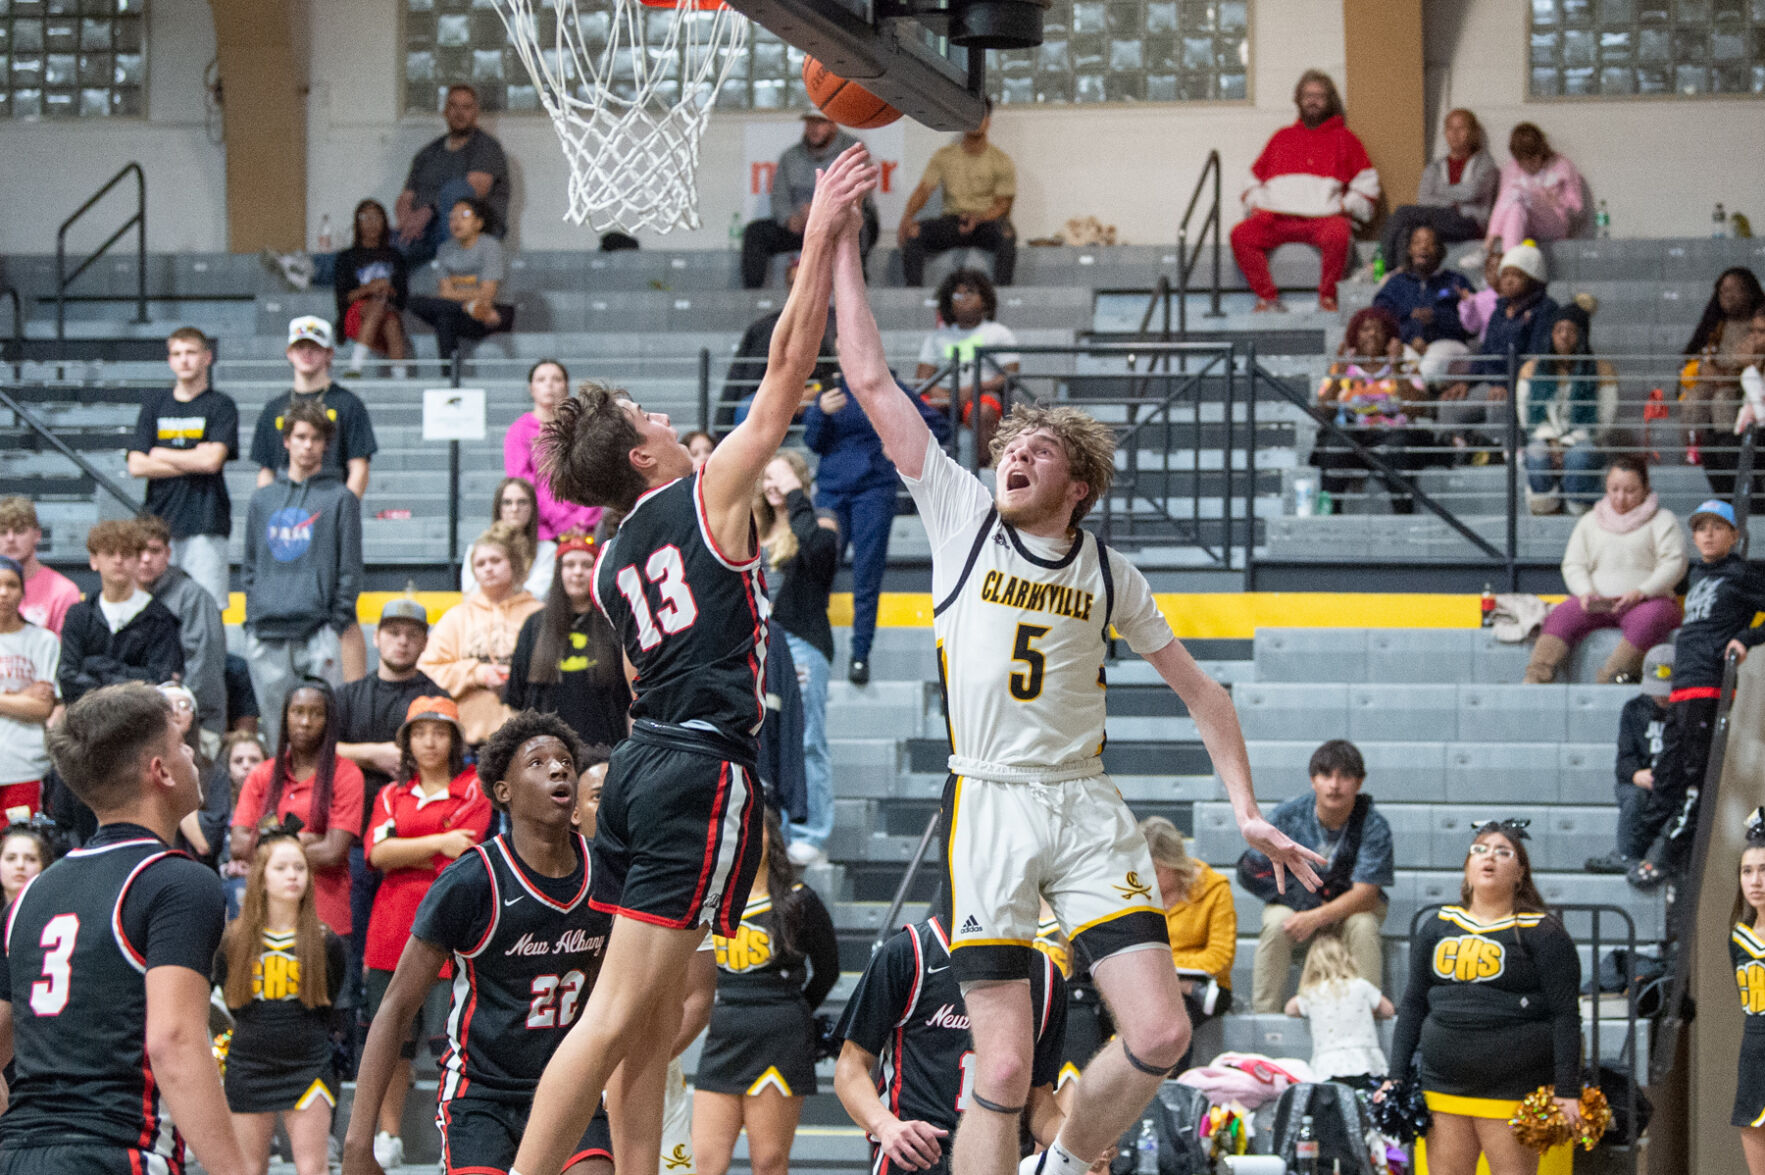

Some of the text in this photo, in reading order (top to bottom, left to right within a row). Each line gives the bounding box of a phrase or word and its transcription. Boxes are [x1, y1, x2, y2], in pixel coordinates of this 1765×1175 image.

[616, 543, 699, 653] 13
[981, 569, 1093, 622] CLARKSVILLE
[1008, 622, 1053, 702] 5
[505, 929, 605, 957] New Albany
[960, 926, 983, 934] adidas
[29, 912, 80, 1017] 3
[1434, 937, 1504, 982] CHS
[525, 968, 587, 1030] 22
[1736, 963, 1765, 1013] CH
